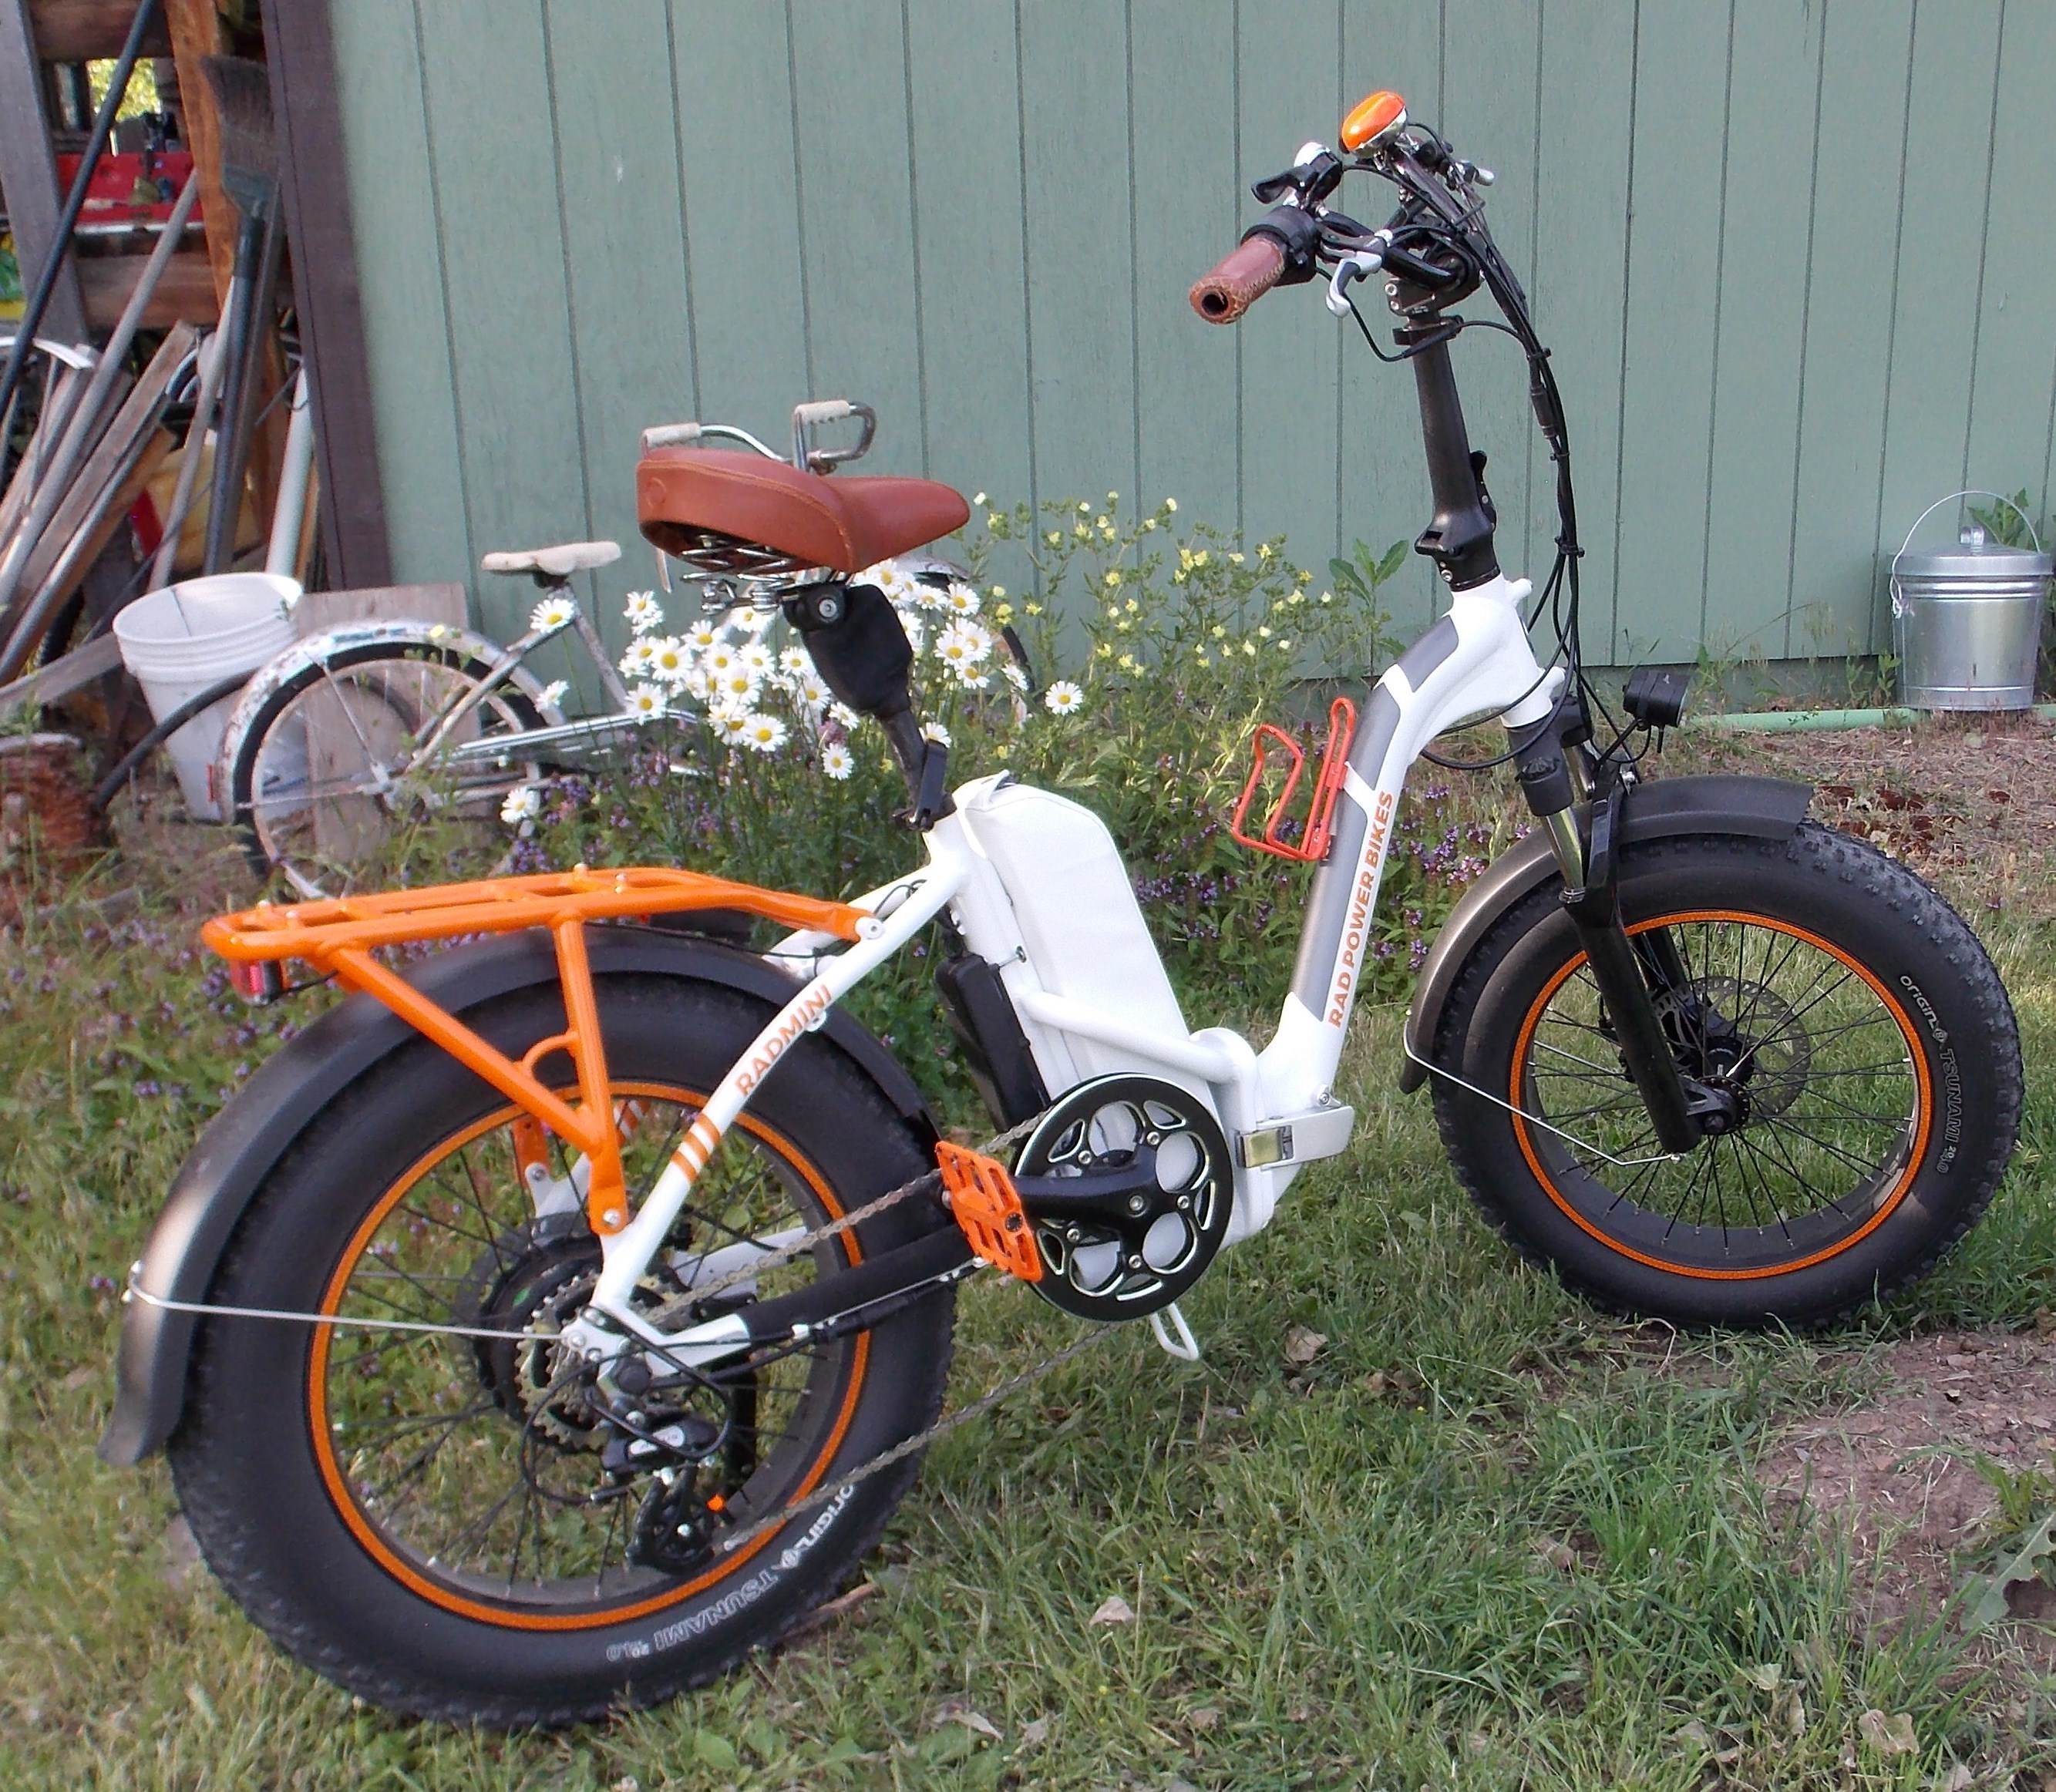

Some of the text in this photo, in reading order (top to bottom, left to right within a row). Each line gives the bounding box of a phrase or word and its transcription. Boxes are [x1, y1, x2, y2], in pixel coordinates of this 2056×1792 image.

[1328, 790, 1394, 1028] RAD POWER BIKES
[735, 984, 833, 1097] RADMINI
[1940, 1048, 1961, 1143] TSUNAMI
[654, 1570, 779, 1651] TSUNAMI
